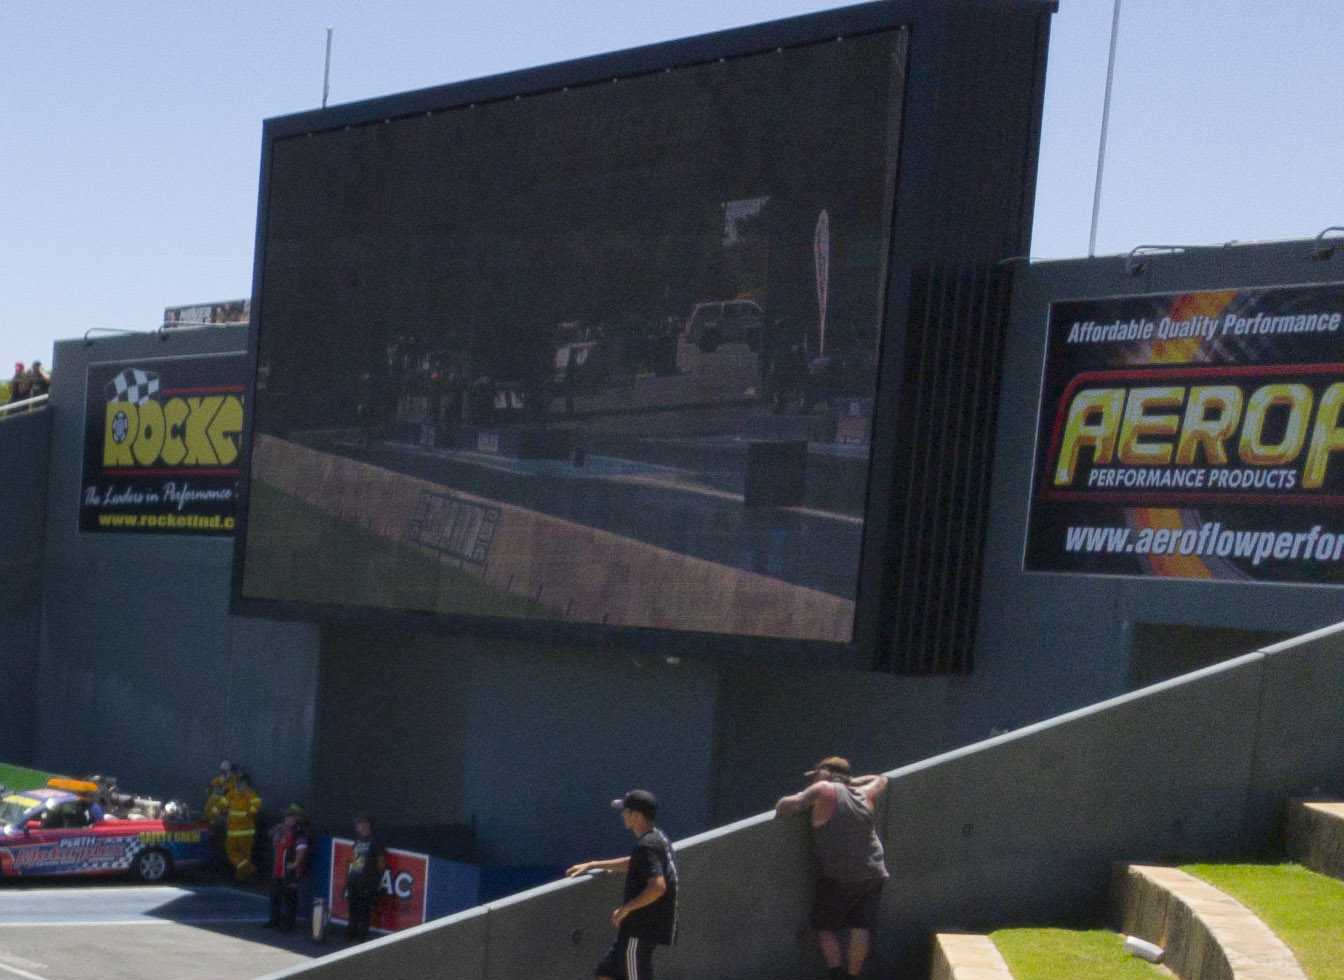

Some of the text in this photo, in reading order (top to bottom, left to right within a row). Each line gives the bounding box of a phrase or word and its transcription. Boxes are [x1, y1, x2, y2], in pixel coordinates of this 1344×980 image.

[1067, 312, 1342, 343] Affordable Quality Performance
[103, 394, 244, 466] ROCKE
[1088, 468, 1297, 488] PERFORMANCE PRODUCTS
